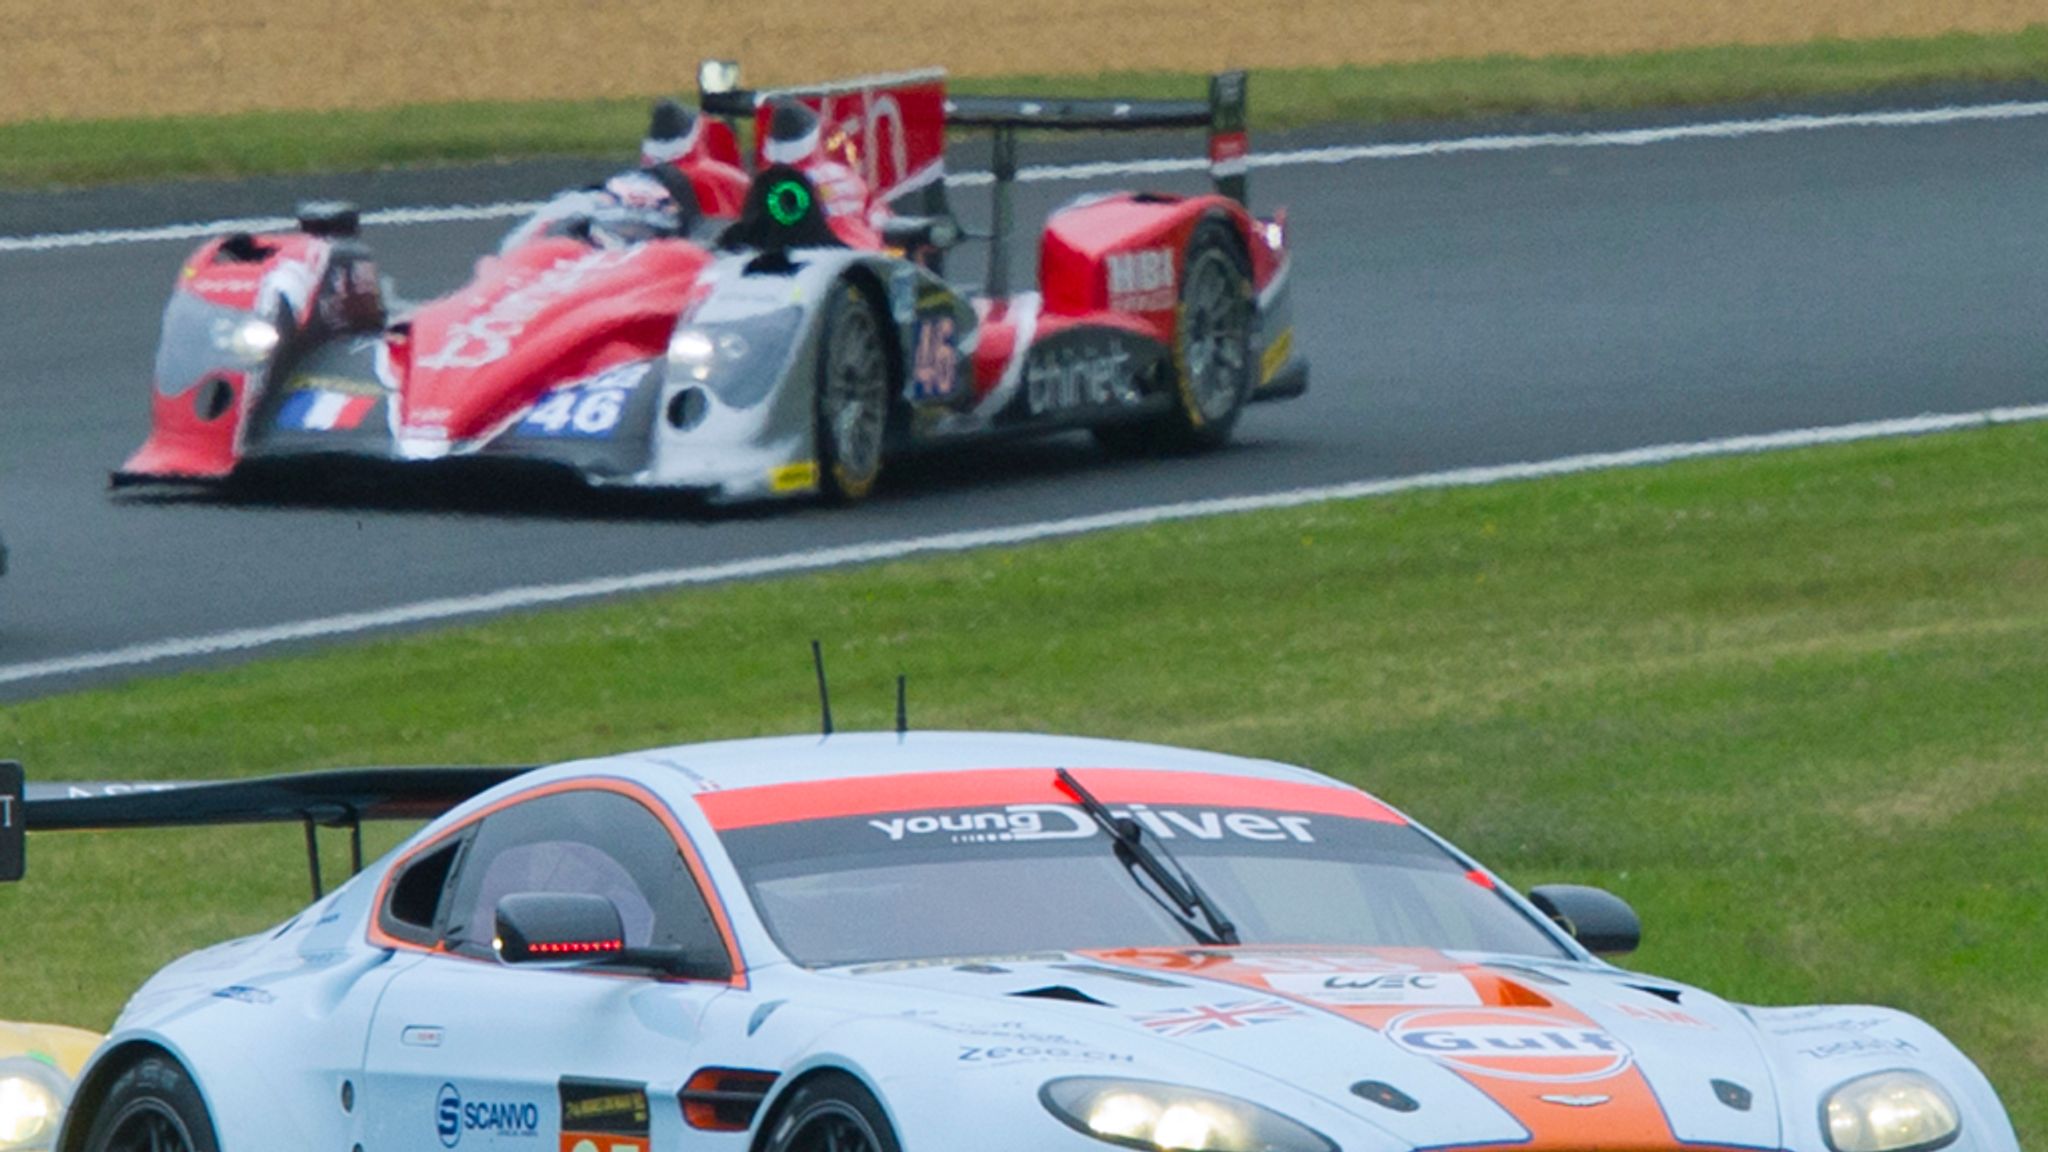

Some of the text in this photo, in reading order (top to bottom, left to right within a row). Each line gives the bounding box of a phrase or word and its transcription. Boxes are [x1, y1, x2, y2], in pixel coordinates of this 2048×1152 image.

[526, 388, 627, 433] 46
[1004, 803, 1315, 843] Diver
[1323, 974, 1438, 991] WEC
[1401, 1029, 1619, 1052] Gulf
[463, 1101, 539, 1130] SCANVO
